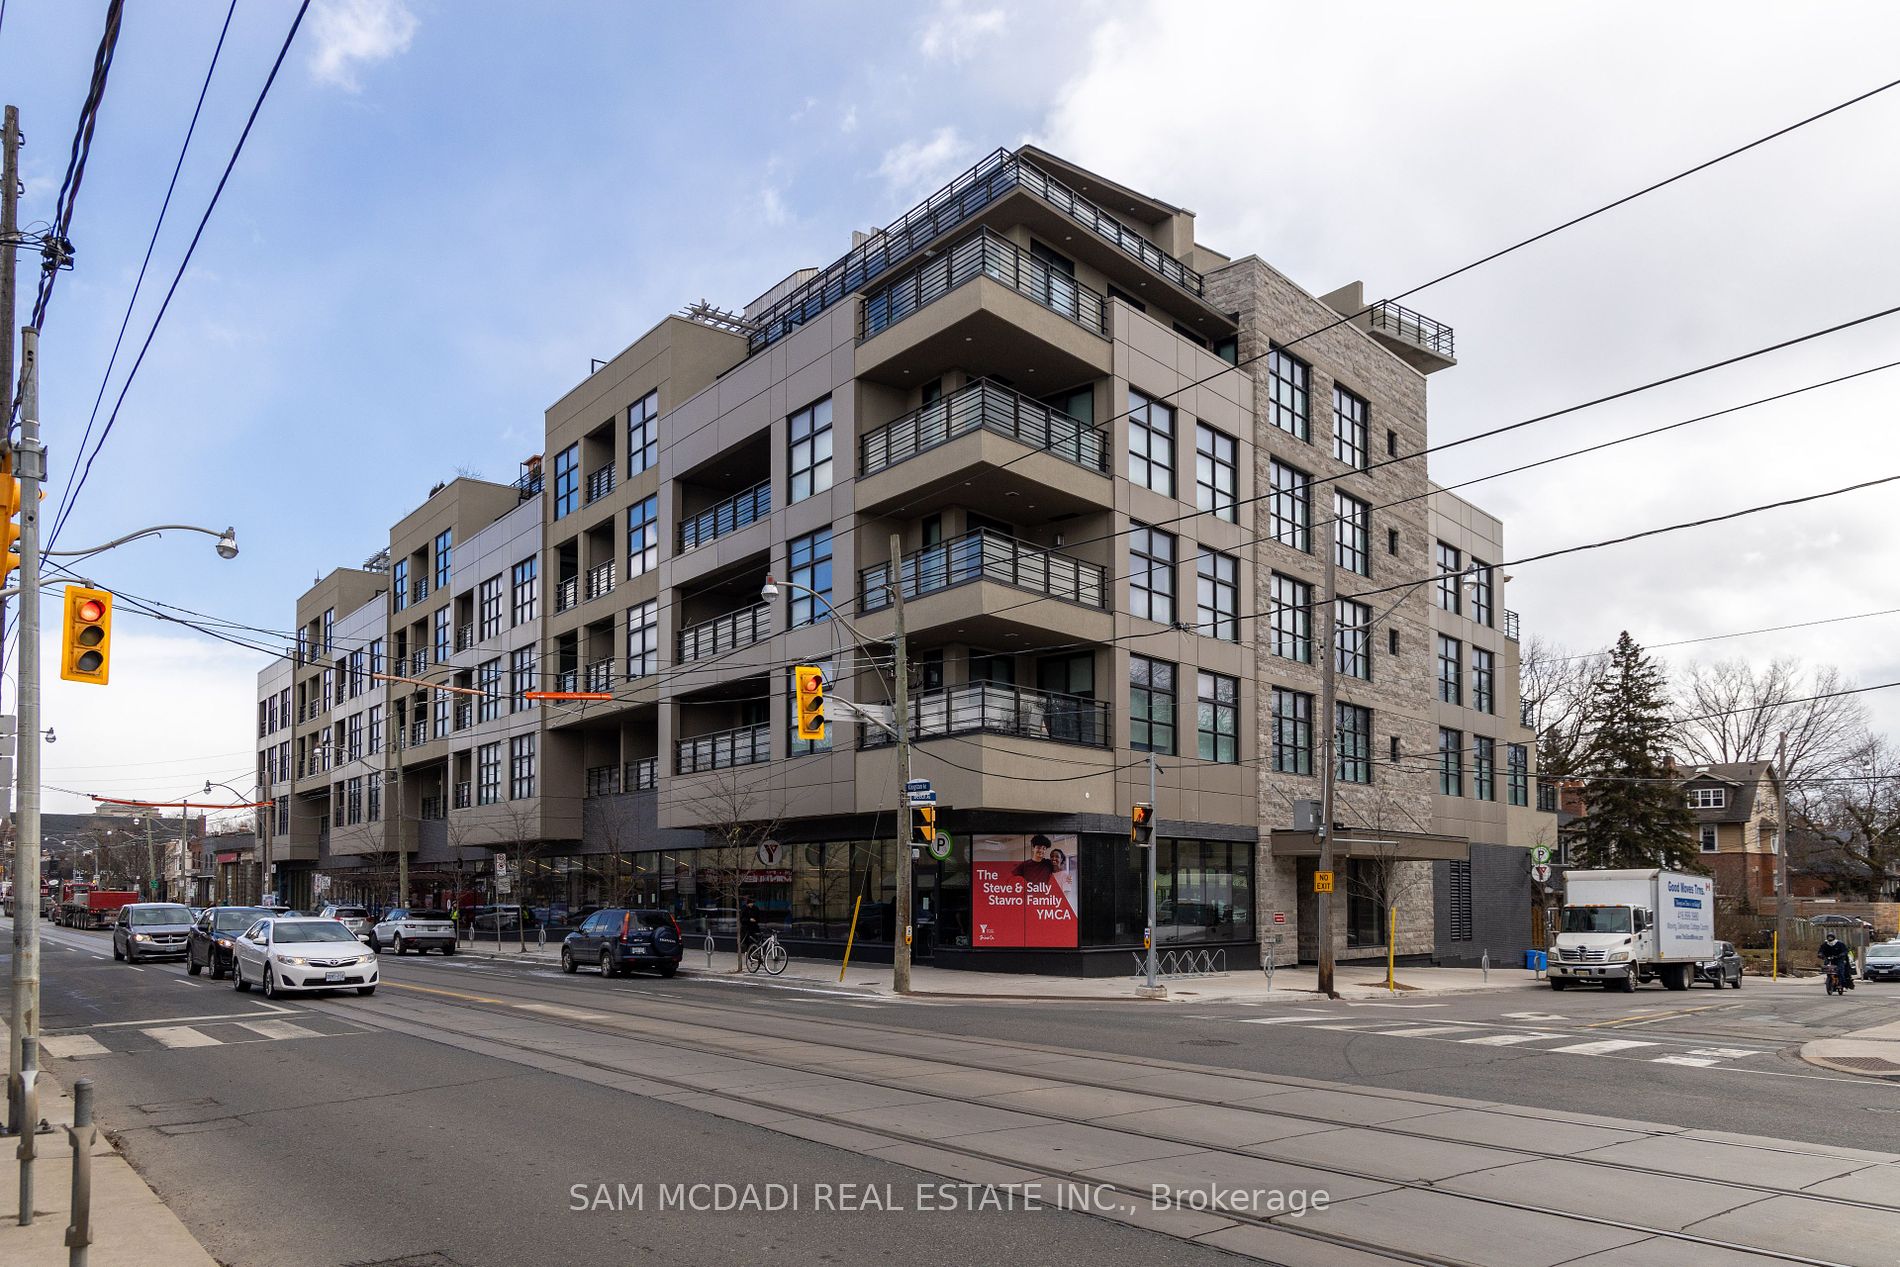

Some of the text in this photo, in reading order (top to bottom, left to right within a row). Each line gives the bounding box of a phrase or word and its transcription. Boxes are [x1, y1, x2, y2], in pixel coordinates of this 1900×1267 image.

[937, 838, 945, 851] P
[1538, 850, 1544, 859] P
[977, 869, 998, 880] The
[1319, 874, 1329, 882] NO
[983, 882, 1052, 895] Steve & Sally
[1316, 882, 1331, 890] EXIT
[988, 895, 1062, 907] Stavro Family
[1036, 909, 1071, 920] YMCA
